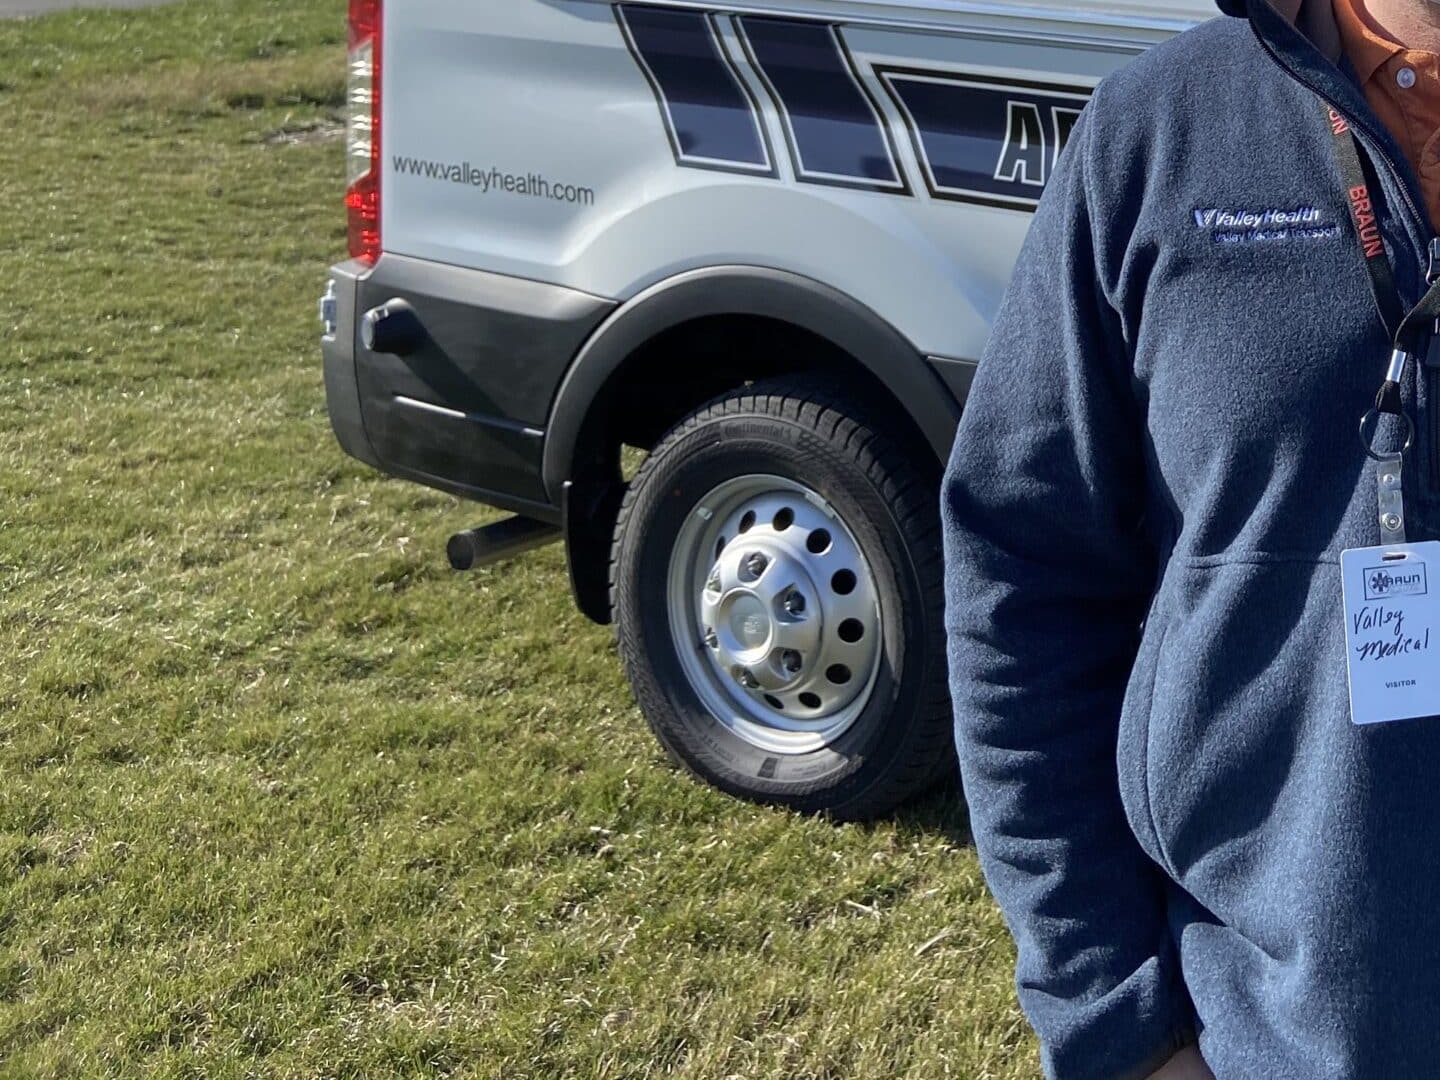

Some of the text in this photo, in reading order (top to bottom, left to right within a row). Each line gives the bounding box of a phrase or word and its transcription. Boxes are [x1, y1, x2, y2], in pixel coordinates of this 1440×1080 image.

[393, 156, 595, 206] www.valleyhealth.com
[1350, 184, 1384, 258] BRAUN
[1353, 606, 1405, 636] Valley
[1385, 679, 1417, 689] VISITOR
